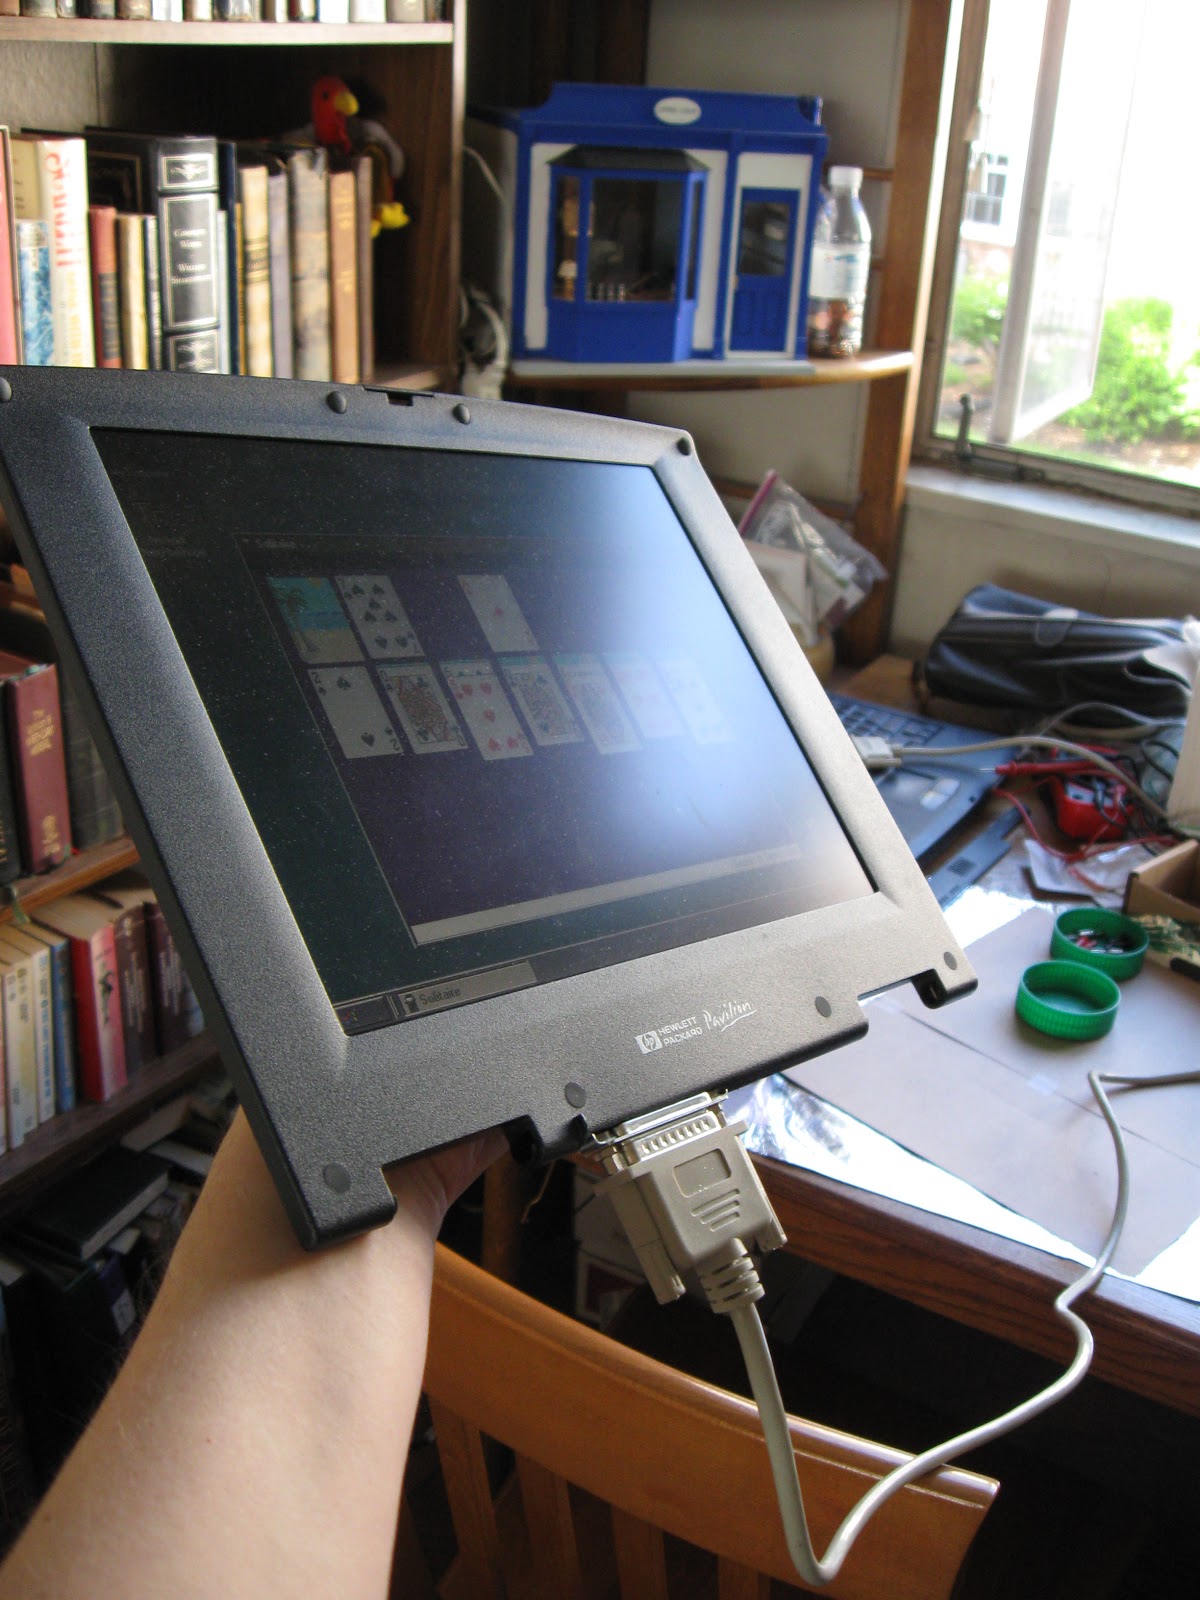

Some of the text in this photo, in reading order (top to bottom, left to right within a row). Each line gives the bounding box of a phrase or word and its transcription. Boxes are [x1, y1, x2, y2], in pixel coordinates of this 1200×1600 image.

[657, 1016, 698, 1037] HEWLETT
[702, 1001, 755, 1031] Pavilion
[662, 1026, 704, 1047] PACKARD
